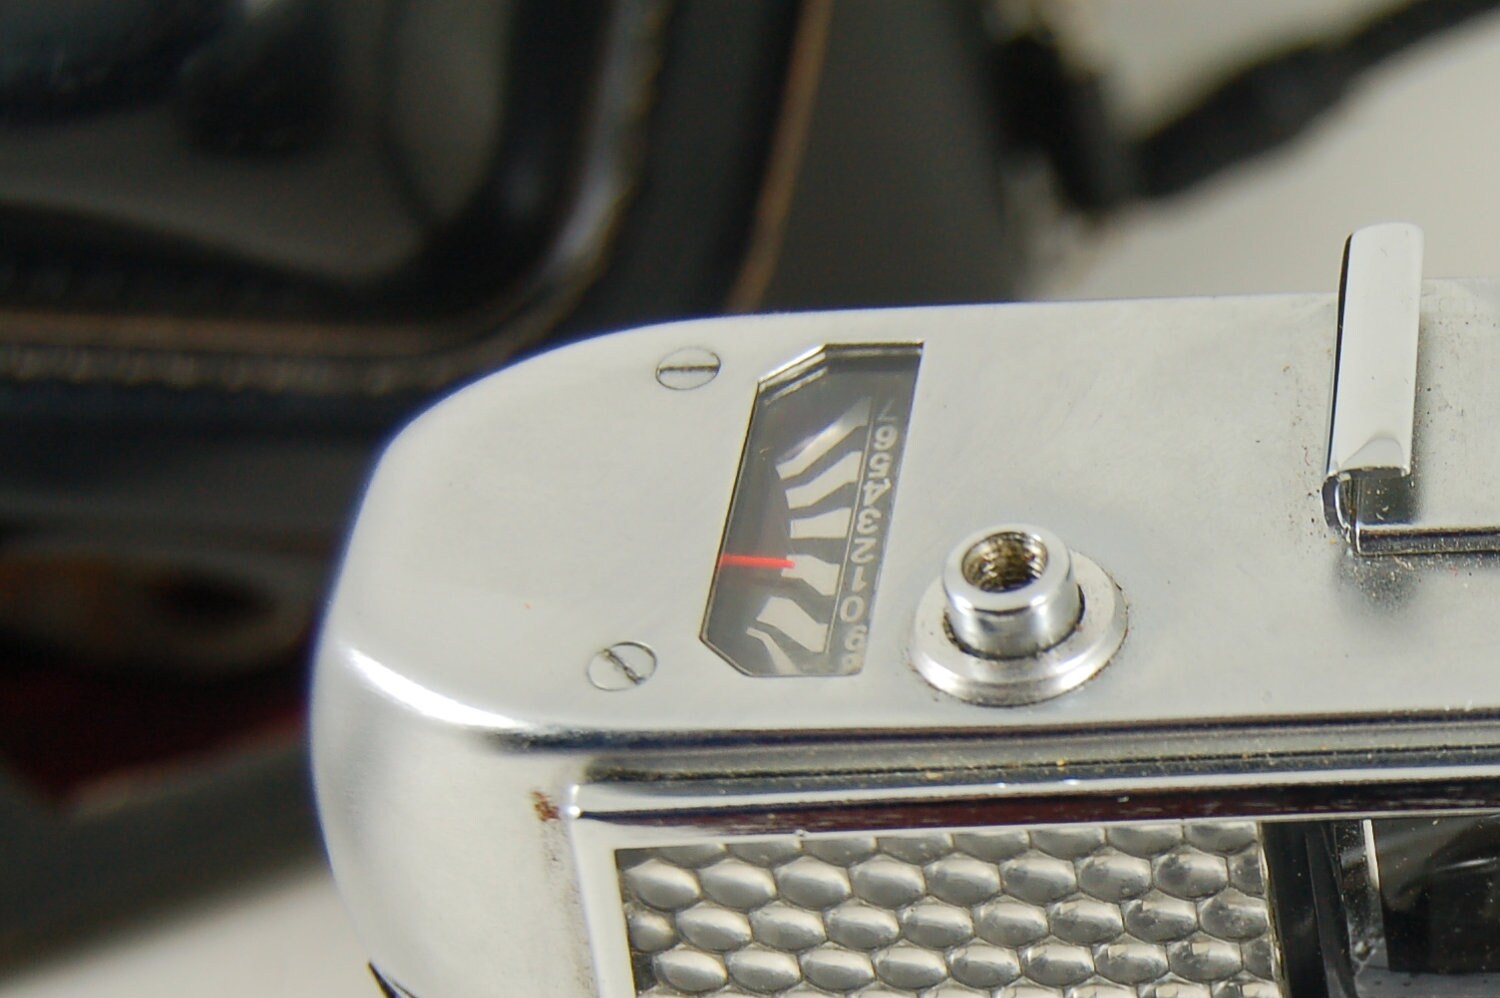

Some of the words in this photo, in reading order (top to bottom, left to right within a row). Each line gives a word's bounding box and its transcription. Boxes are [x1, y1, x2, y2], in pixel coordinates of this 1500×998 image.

[873, 424, 899, 450] 6
[868, 453, 893, 479] 5
[862, 478, 892, 505] 4
[856, 508, 882, 534] 3
[850, 538, 876, 564] 2
[851, 568, 867, 593] 1
[840, 595, 866, 623] 0
